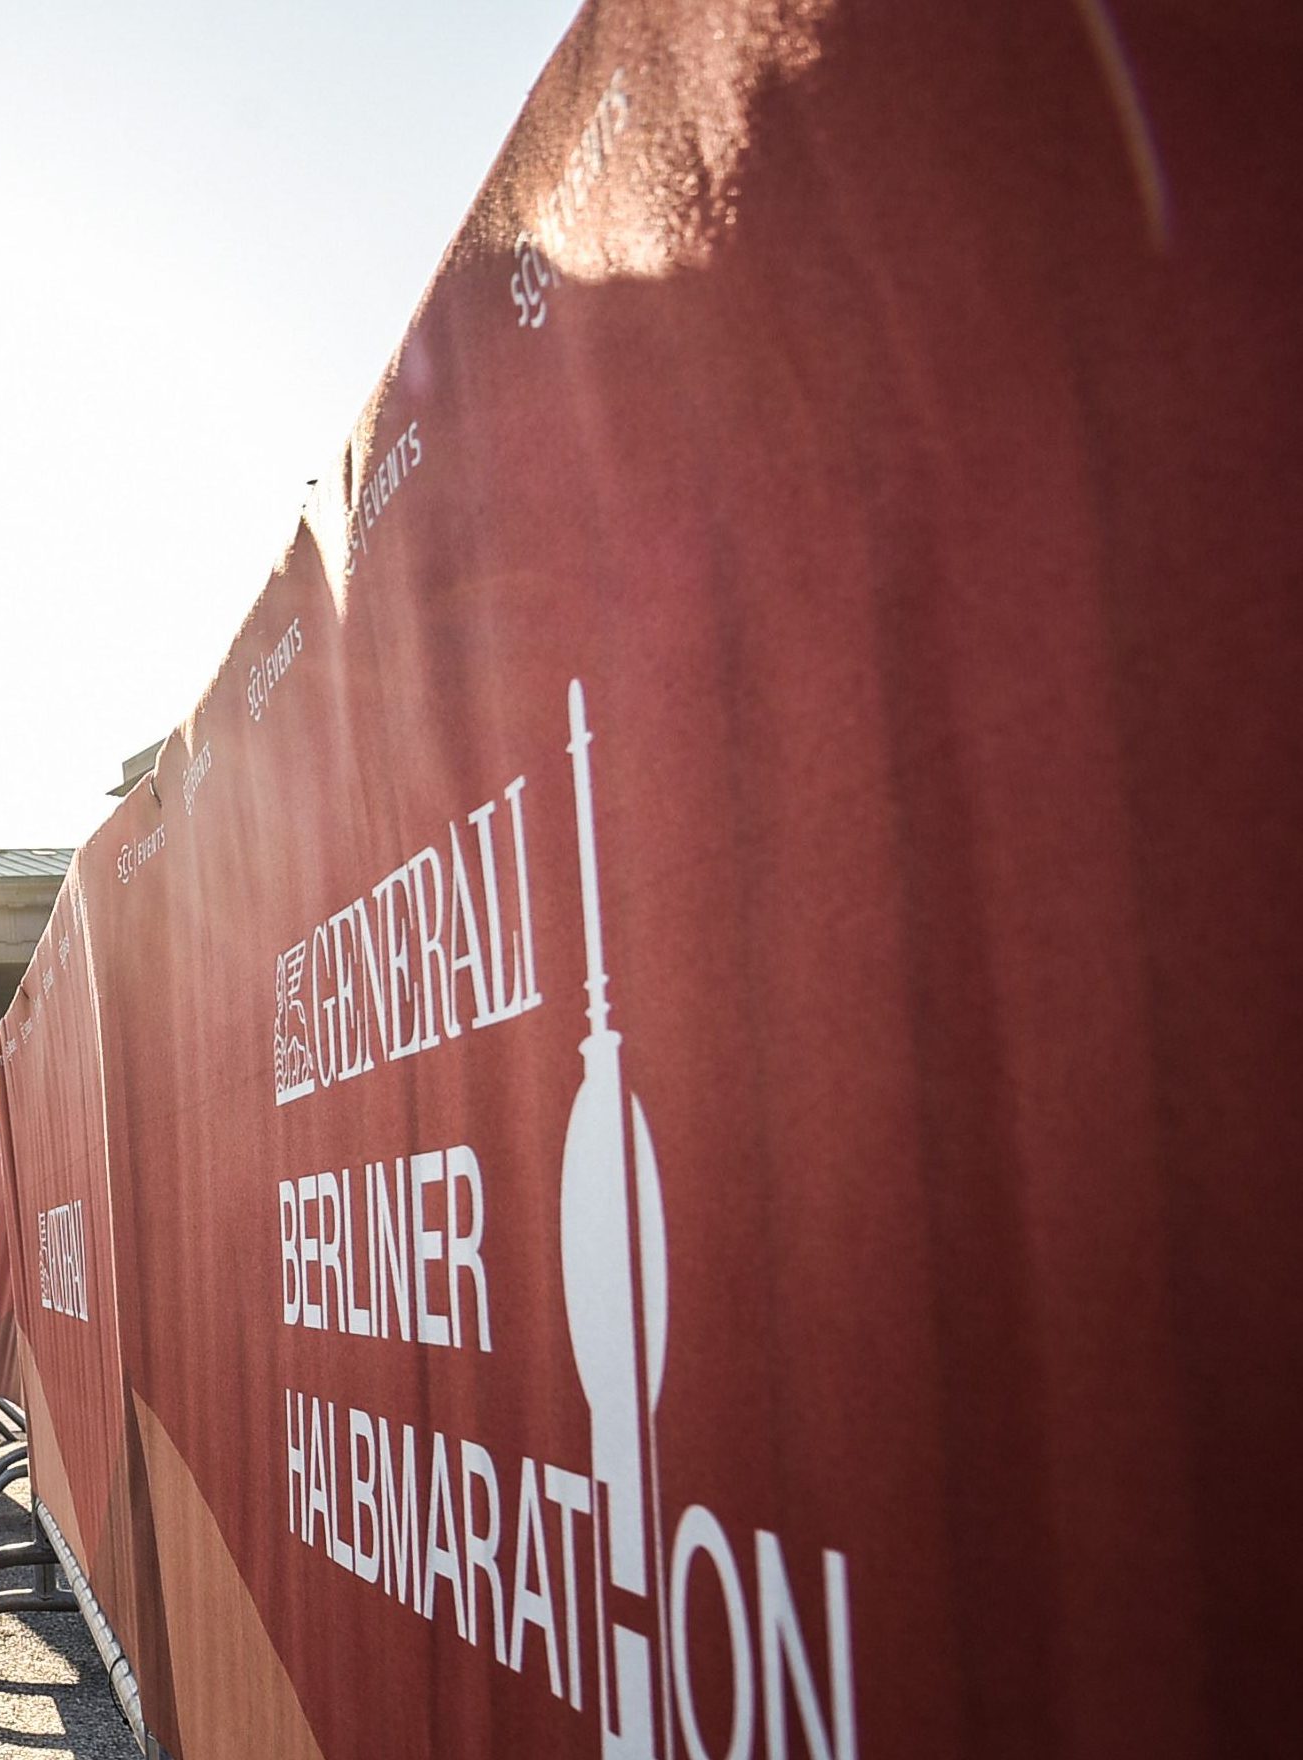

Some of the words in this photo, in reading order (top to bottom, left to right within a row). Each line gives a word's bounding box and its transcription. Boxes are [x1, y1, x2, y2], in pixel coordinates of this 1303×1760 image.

[361, 421, 423, 530] EVENTS
[265, 617, 303, 691] EVENTS
[137, 823, 166, 866] EVENTS
[312, 775, 542, 1088] GENERALI
[278, 1144, 493, 1353] BERLINER
